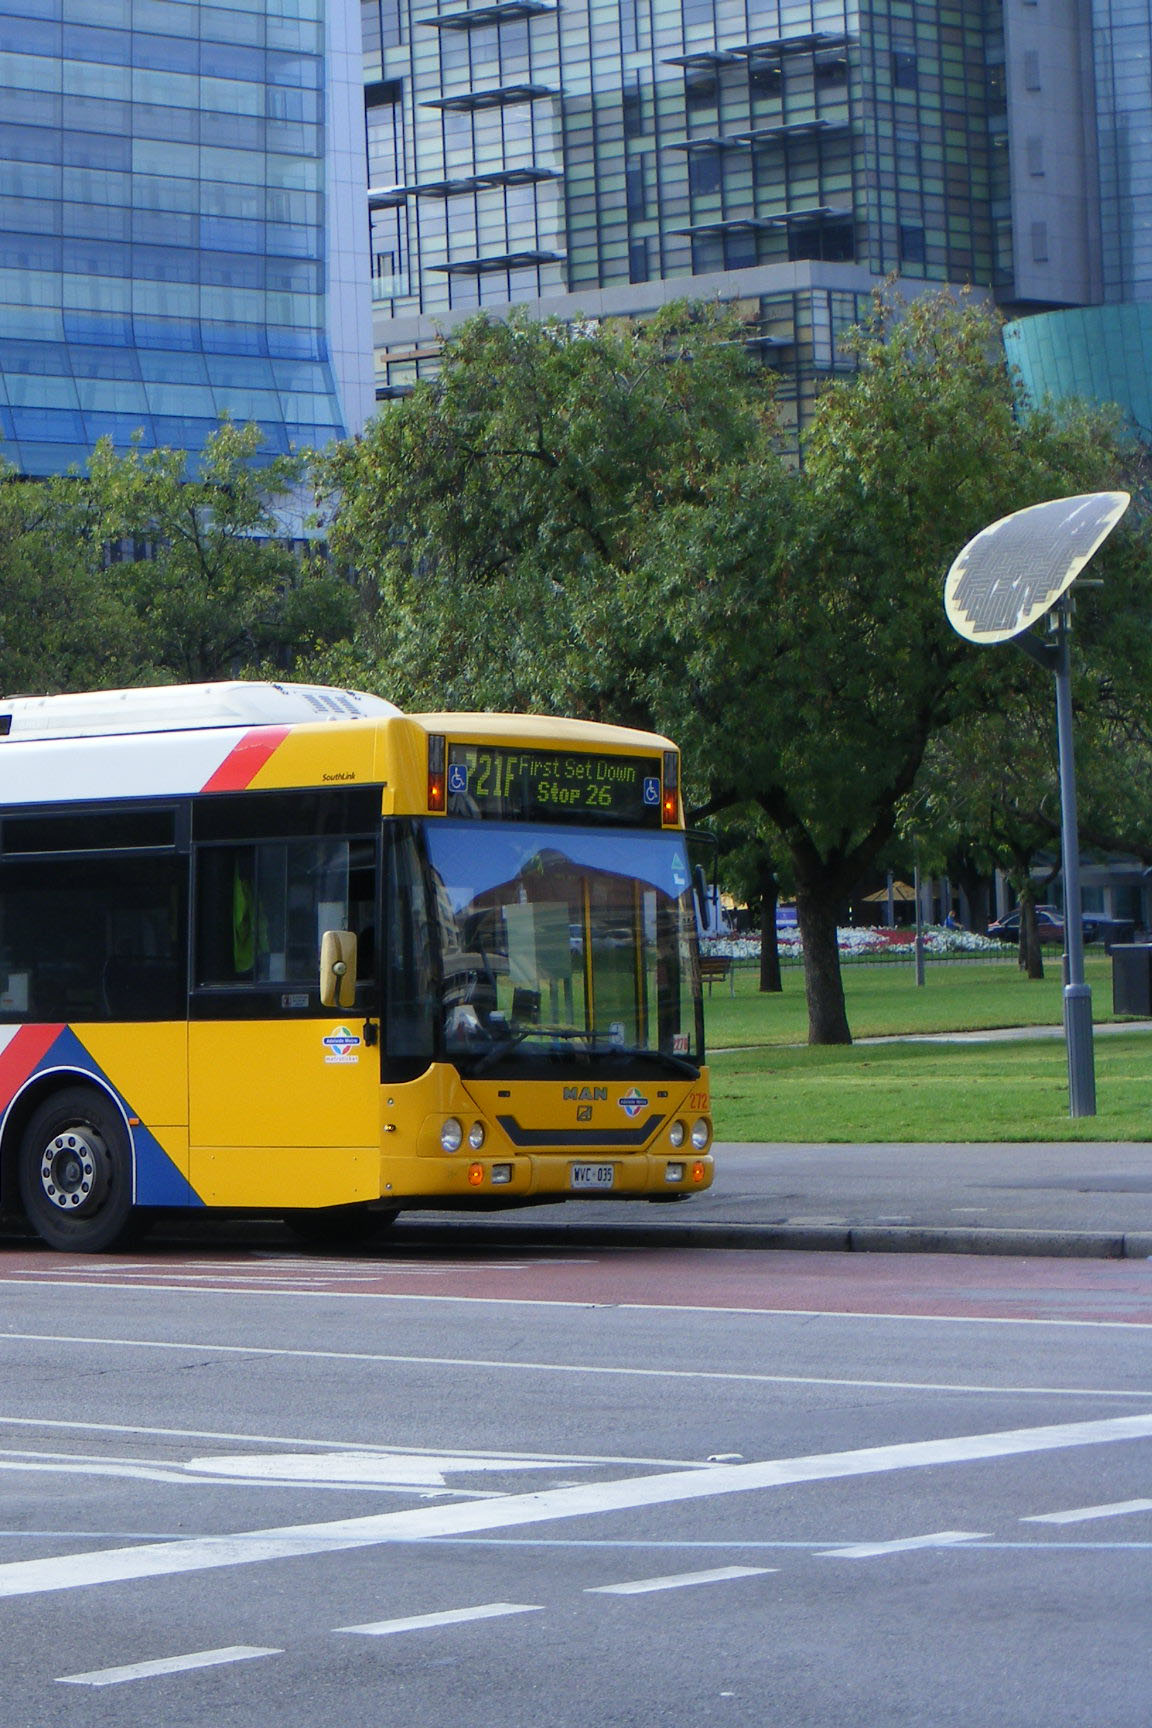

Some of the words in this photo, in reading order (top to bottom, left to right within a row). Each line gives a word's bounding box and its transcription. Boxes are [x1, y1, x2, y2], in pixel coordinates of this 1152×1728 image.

[322, 772, 356, 781] SouthLink
[519, 754, 560, 779] First
[564, 759, 593, 780] Set
[598, 761, 636, 783] Down
[537, 781, 580, 804] Stop
[585, 784, 612, 806] 26
[563, 1087, 608, 1100] MAN
